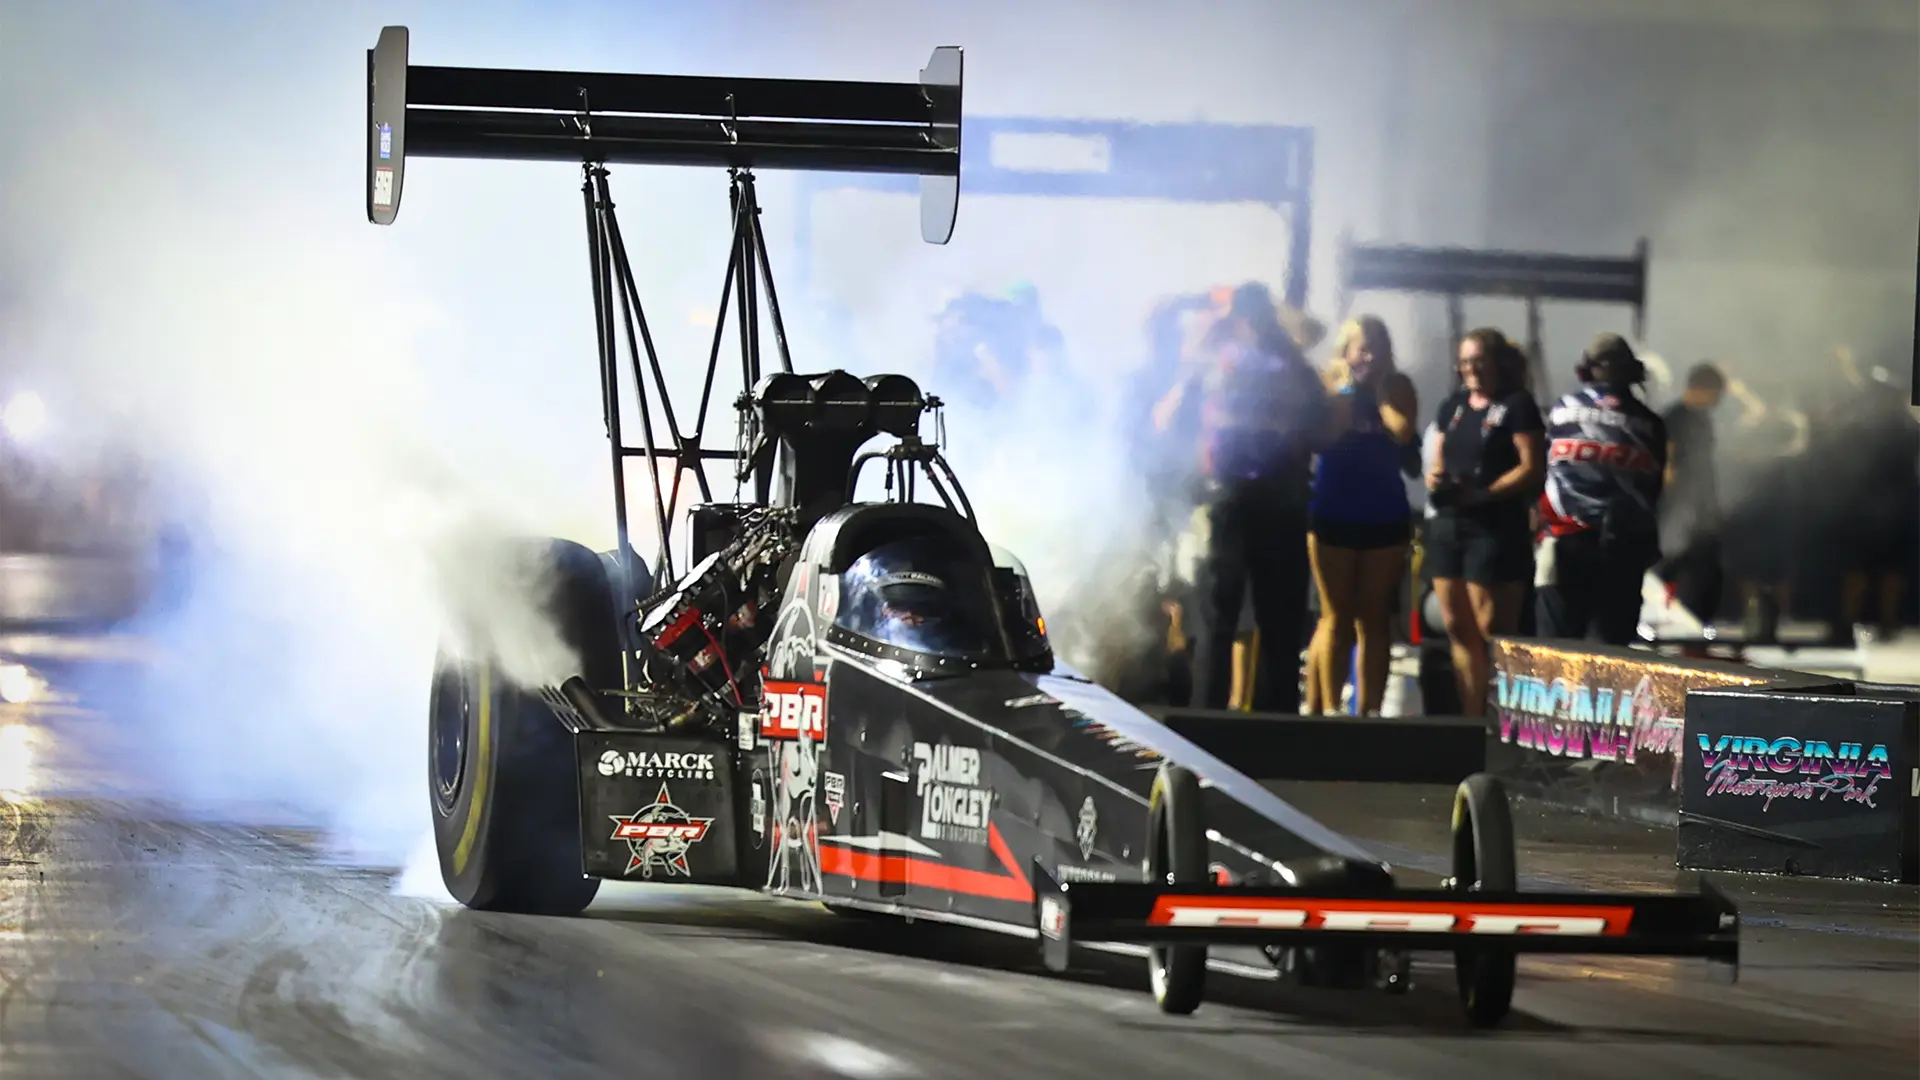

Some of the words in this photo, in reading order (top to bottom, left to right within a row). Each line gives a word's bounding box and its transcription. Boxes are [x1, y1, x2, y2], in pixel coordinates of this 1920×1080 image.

[762, 692, 823, 732] PBR
[625, 767, 715, 780] RECYCLING
[626, 751, 715, 770] MARCK
[914, 741, 981, 797] PALMER
[1697, 733, 1892, 779] VIRGINIA
[1705, 759, 1816, 812] Motorsports
[1817, 773, 1877, 809] Park
[619, 825, 702, 838] PBR
[920, 783, 993, 839] LONGLEY
